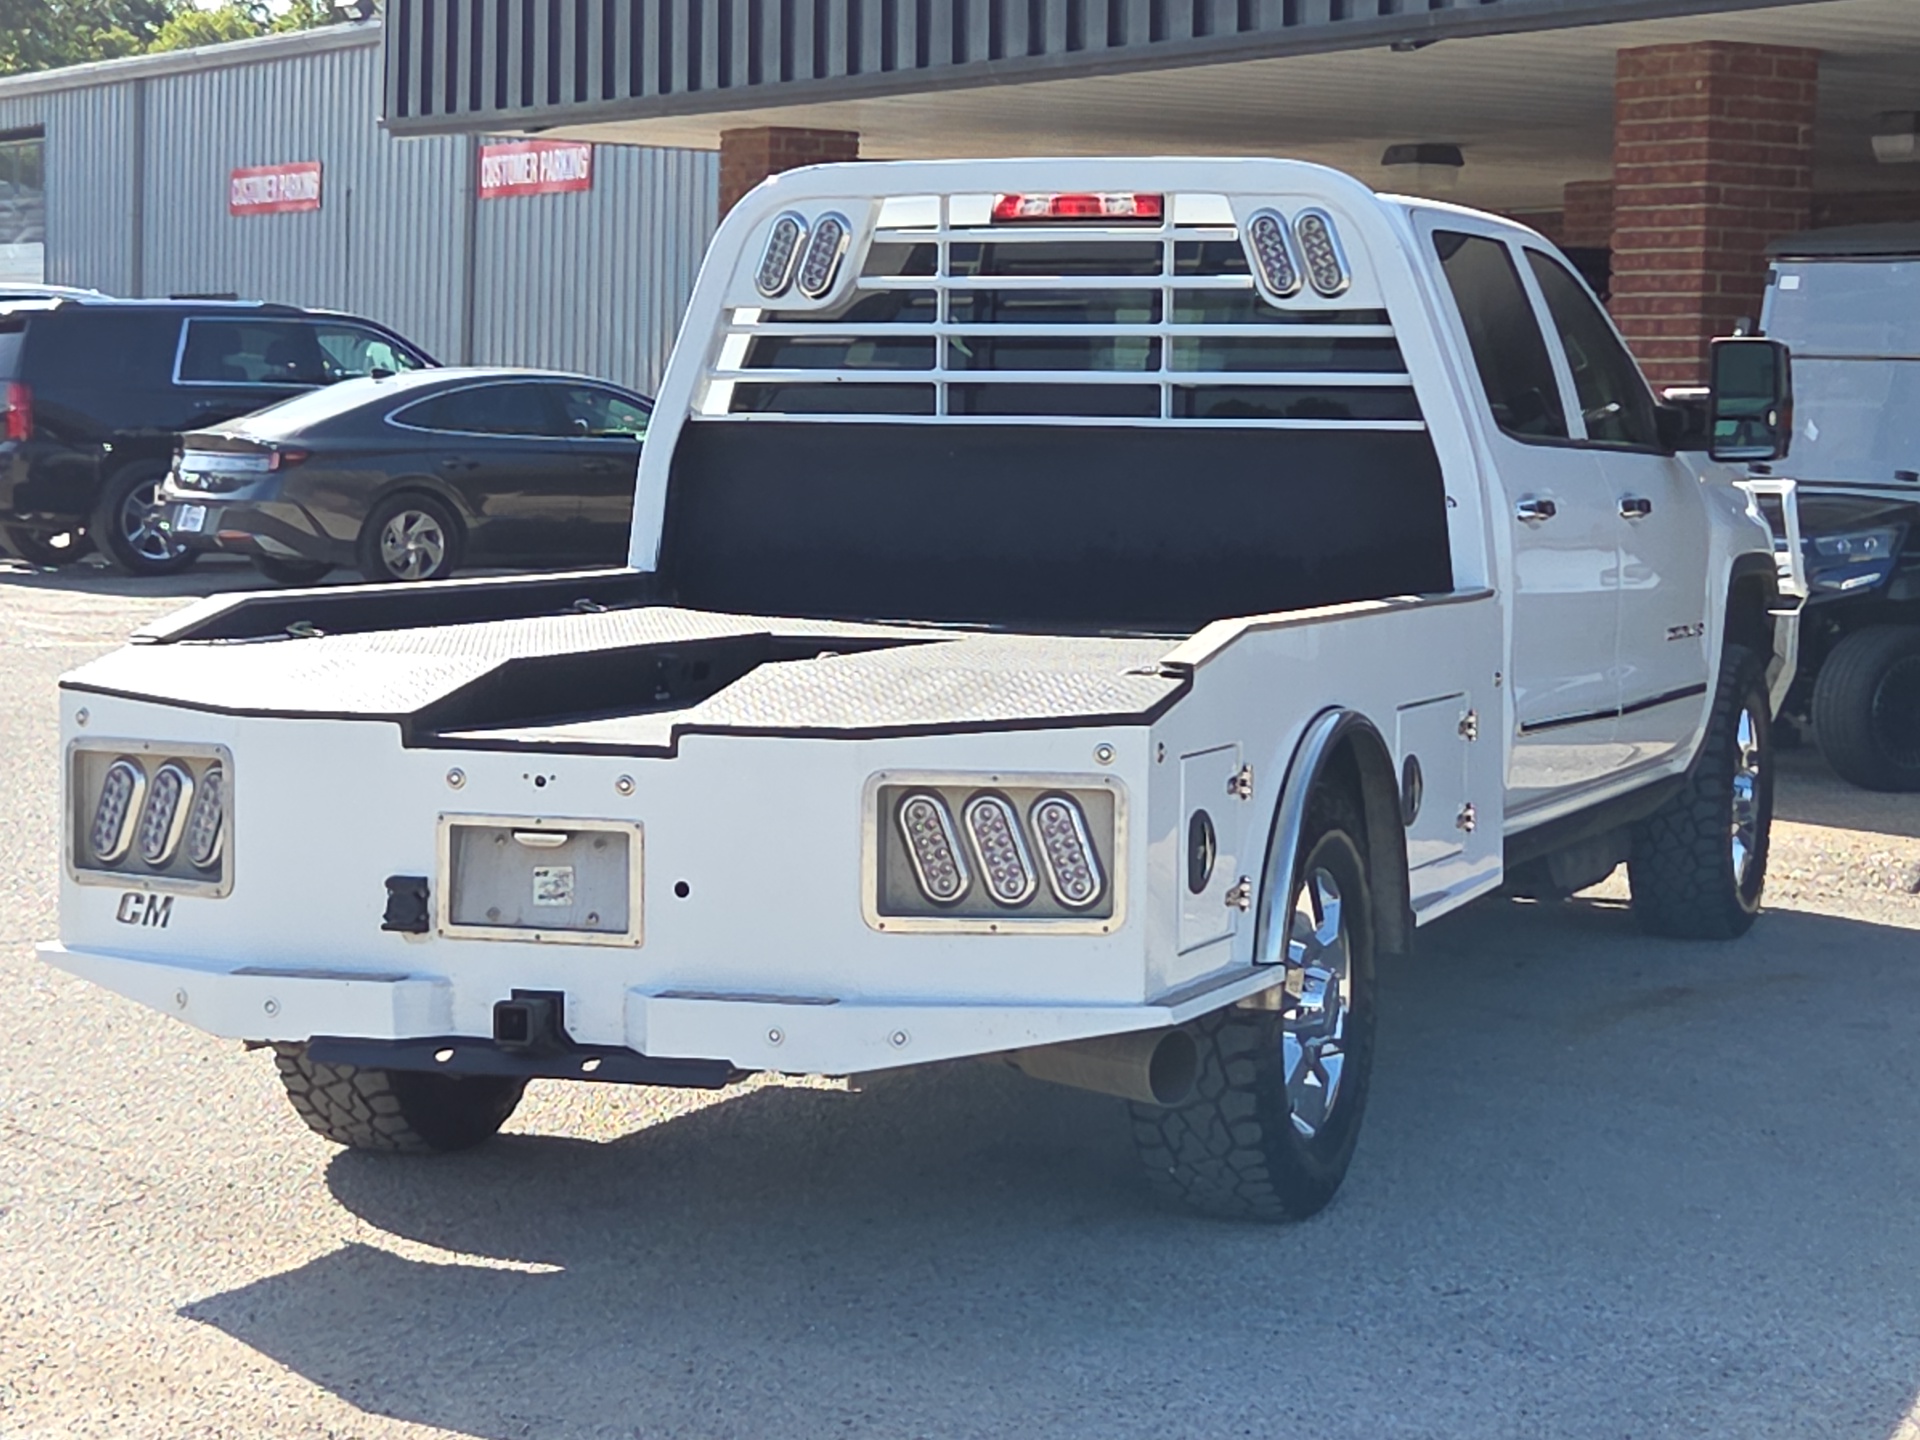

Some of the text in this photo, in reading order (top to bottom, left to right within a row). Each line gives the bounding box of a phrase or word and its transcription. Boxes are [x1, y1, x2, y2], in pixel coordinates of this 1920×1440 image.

[481, 146, 588, 188] CUSTOMER PARKING
[116, 892, 174, 928] CM
